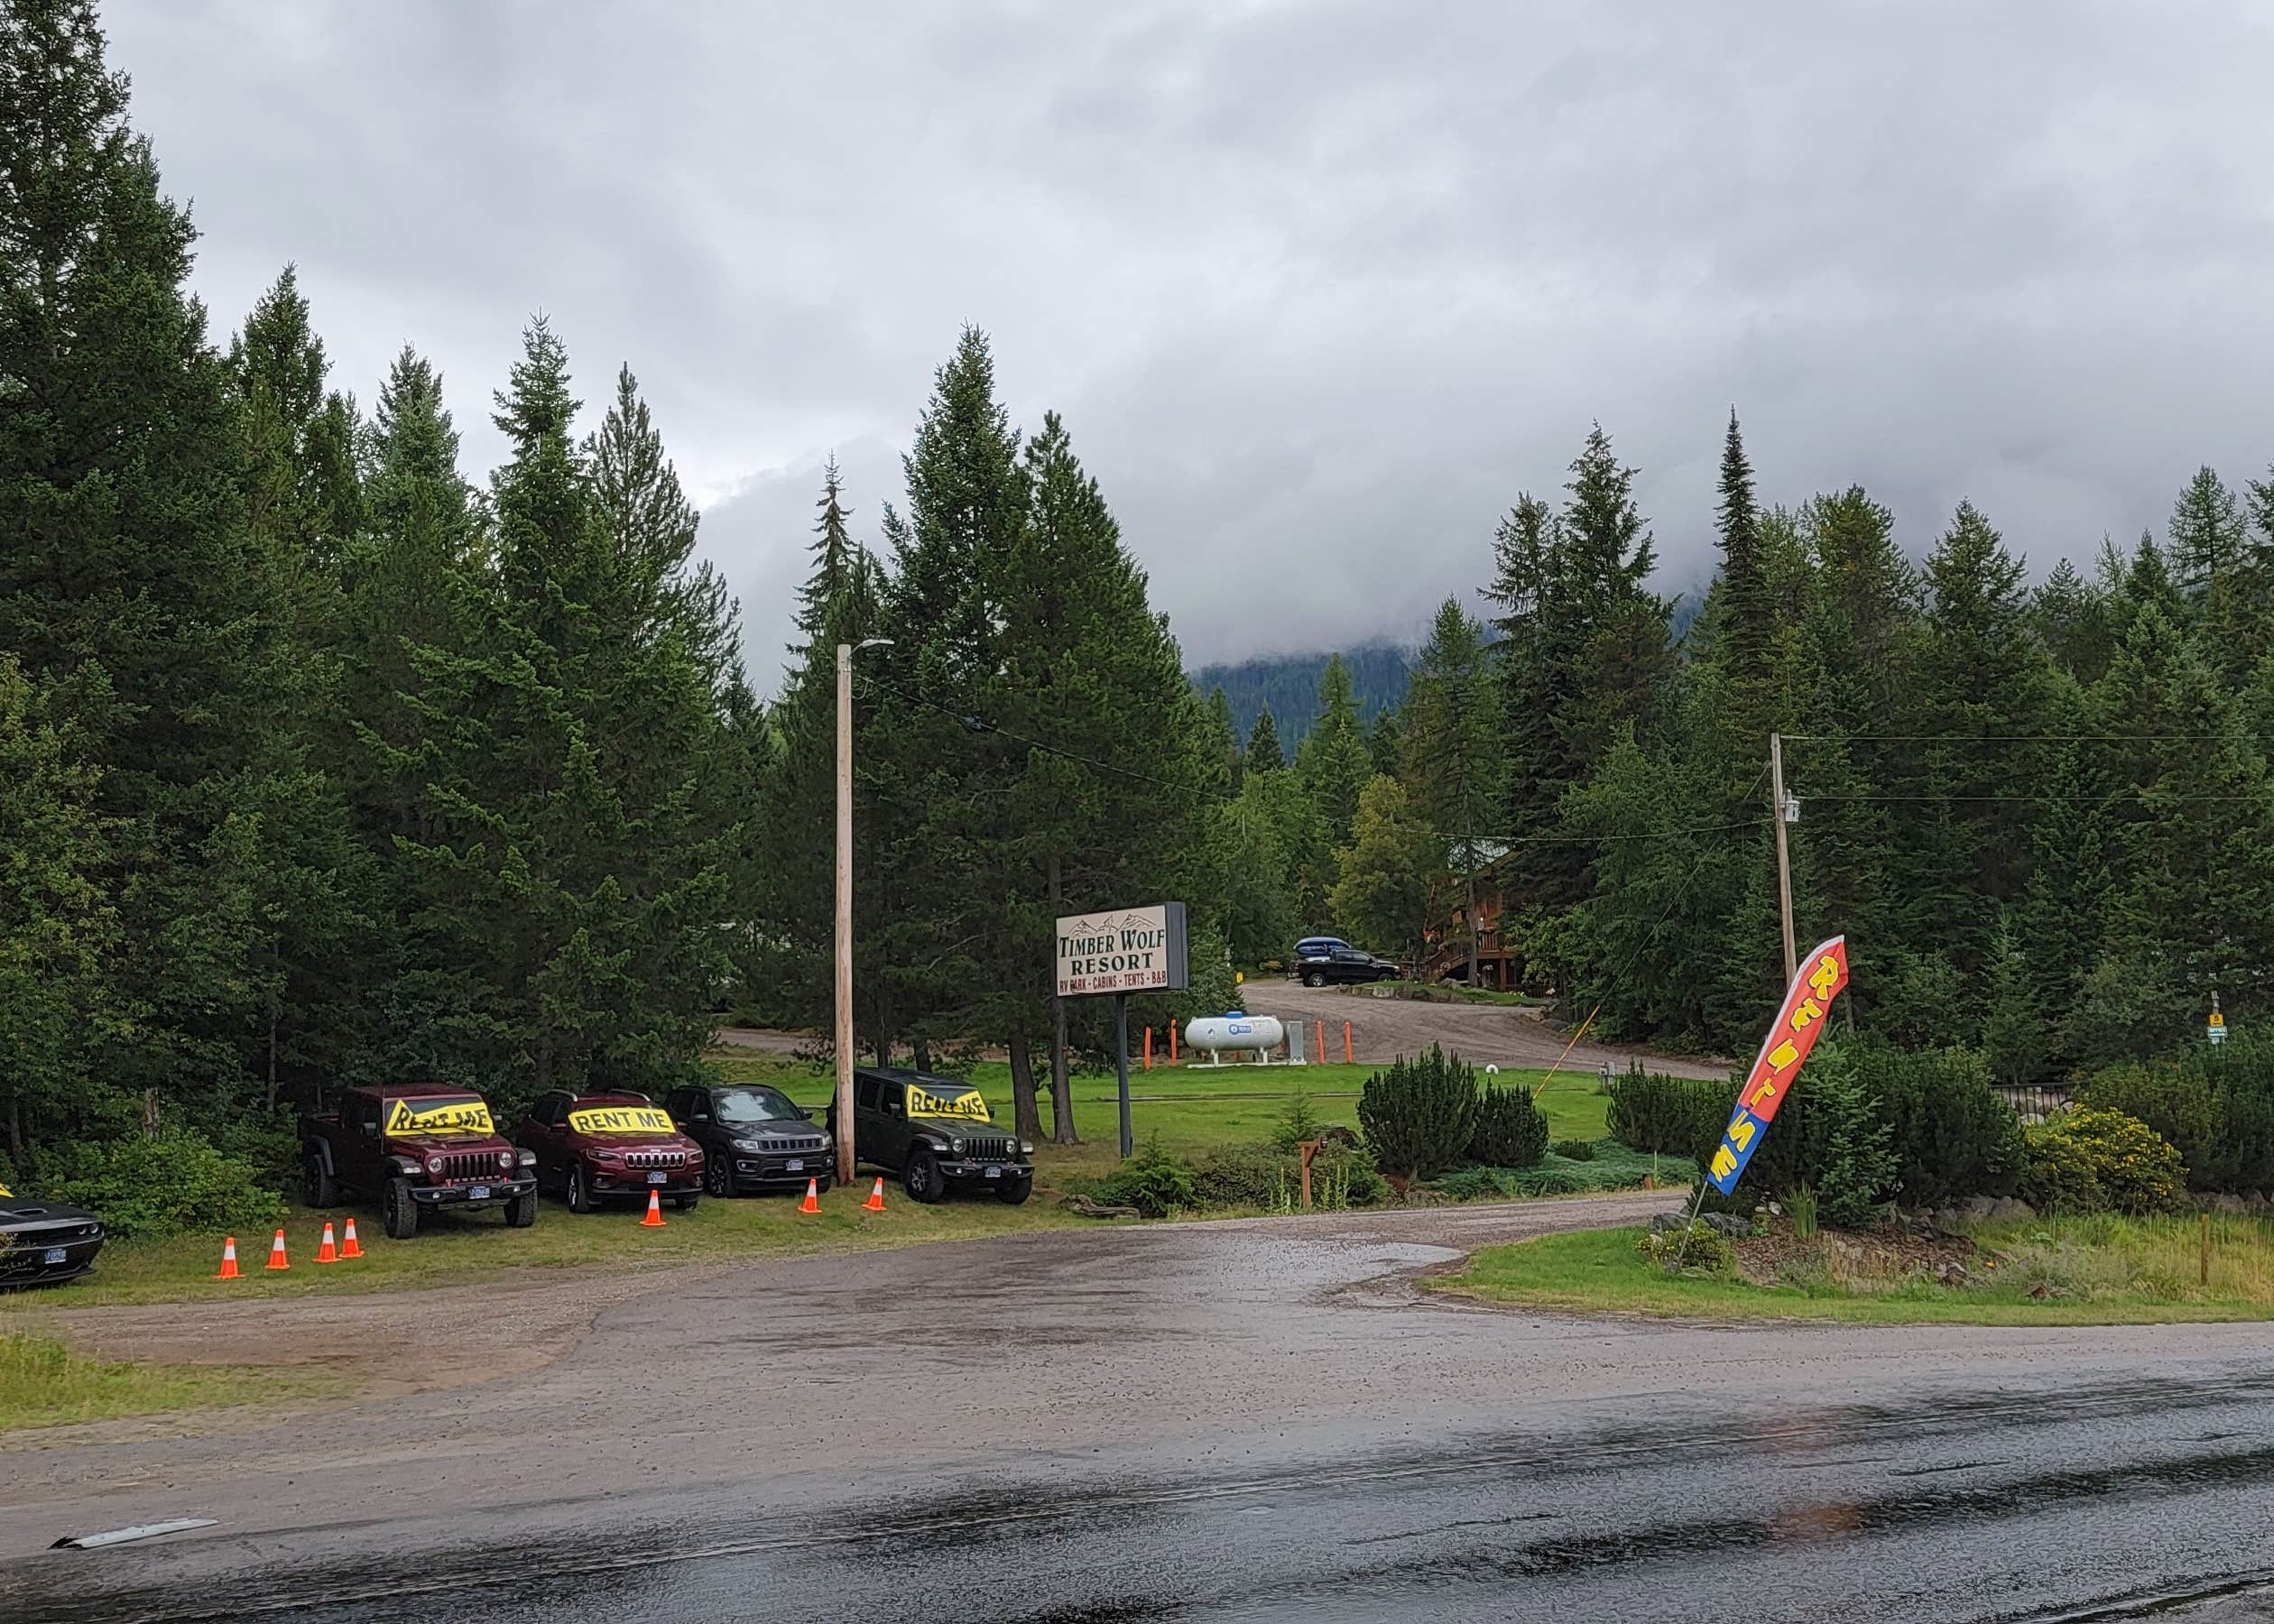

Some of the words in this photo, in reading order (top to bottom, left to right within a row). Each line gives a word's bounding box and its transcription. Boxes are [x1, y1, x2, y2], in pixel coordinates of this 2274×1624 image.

[1059, 935, 1114, 957] TIMBER
[1121, 928, 1165, 952] WOLF
[1071, 952, 1153, 975] RESORT
[1059, 979, 1068, 992] RV
[1093, 975, 1117, 990] CABINS
[1123, 973, 1145, 987] TENTS
[1151, 971, 1167, 984] B&B
[575, 1112, 632, 1131] RENT
[635, 1112, 670, 1129] ME
